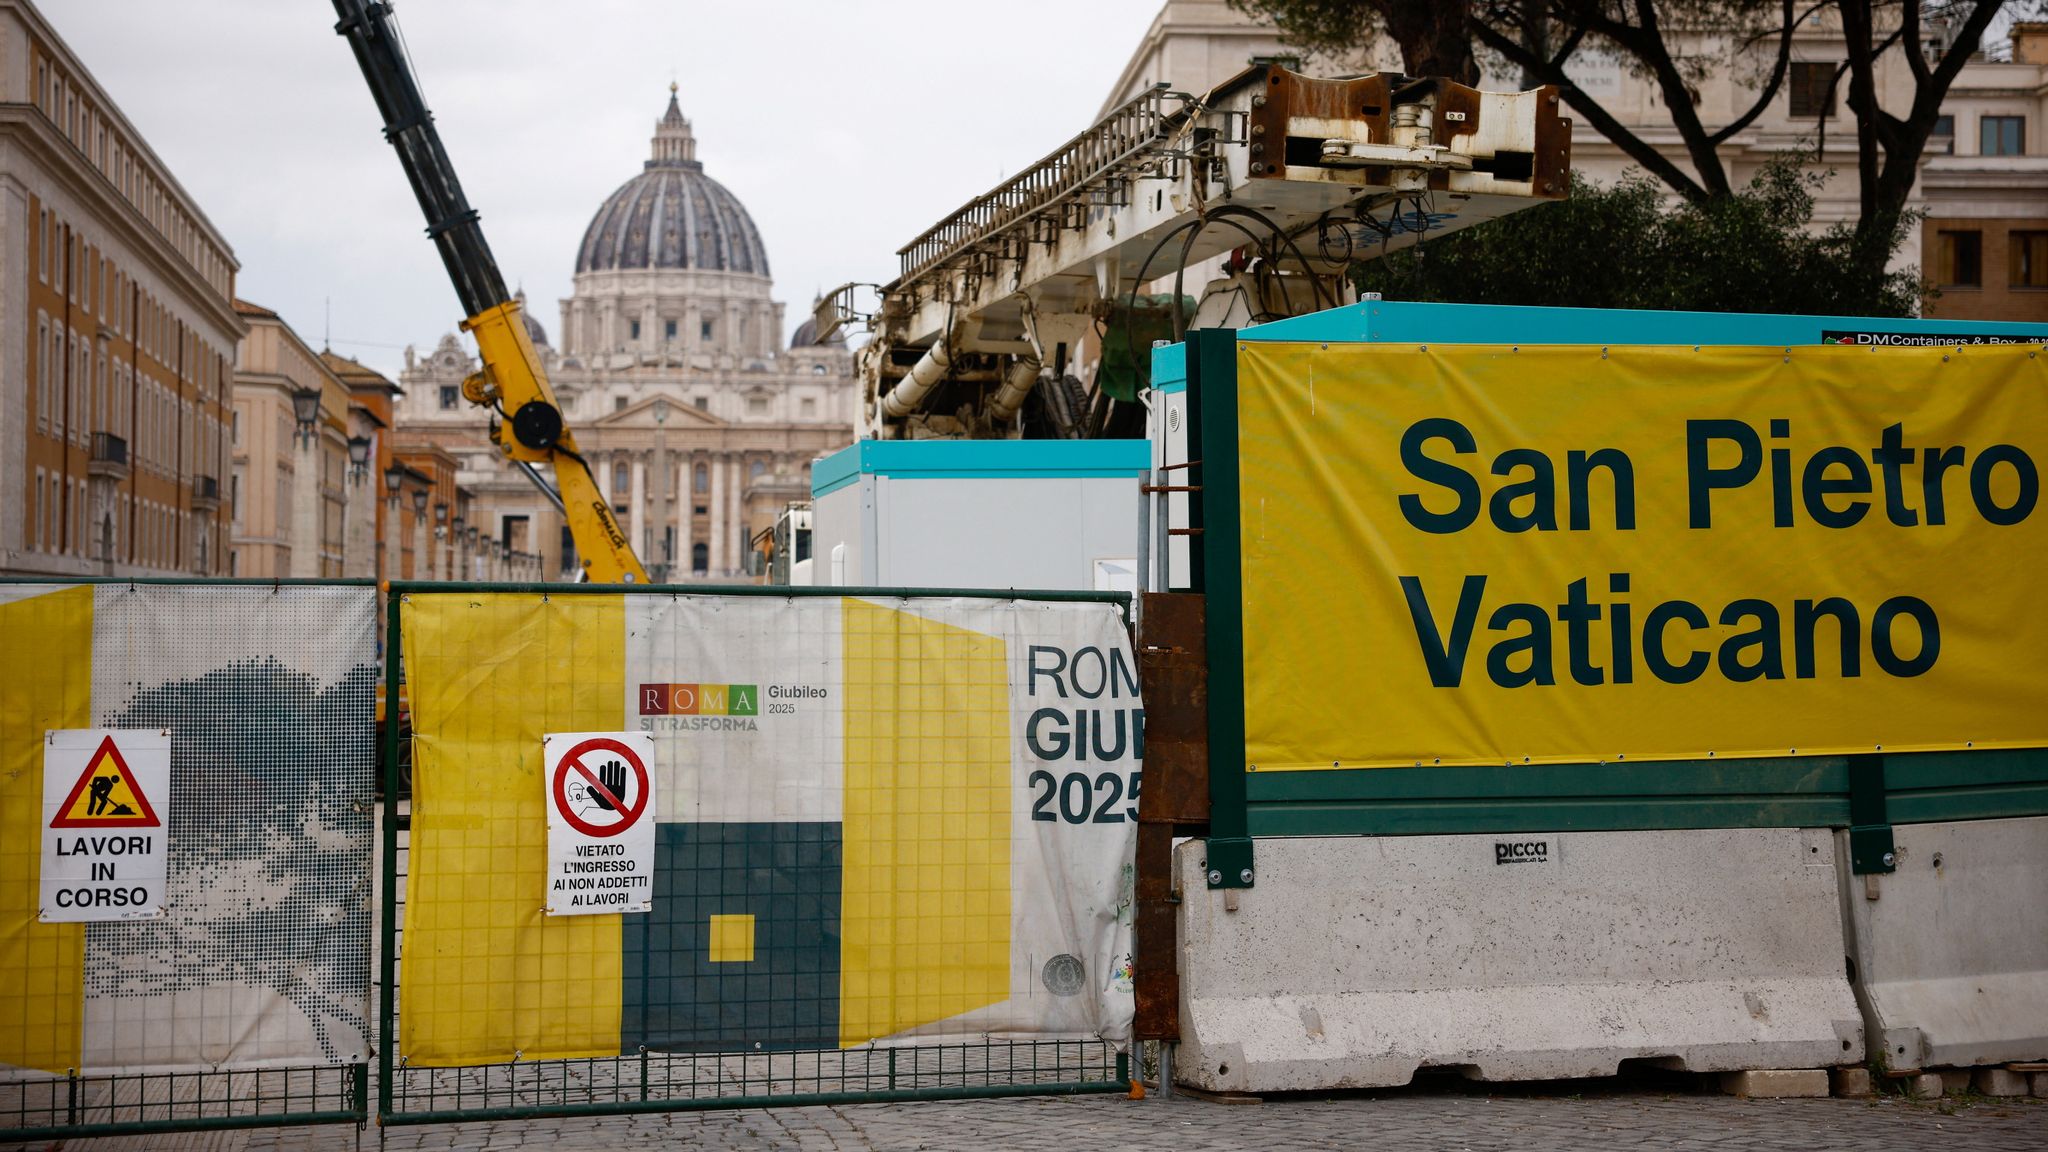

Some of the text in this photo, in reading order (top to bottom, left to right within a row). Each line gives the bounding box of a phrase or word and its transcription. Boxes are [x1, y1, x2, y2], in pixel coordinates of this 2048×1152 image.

[1398, 417, 2039, 534] San Pietro
[1398, 573, 1941, 688] Vaticano
[645, 688, 752, 711] ROMA
[768, 685, 827, 699] Giubileo
[768, 703, 795, 714] 2025
[640, 717, 759, 732] SI TRASFORMA
[57, 836, 152, 856] LAVORI
[576, 844, 625, 857] VIETATO
[1495, 842, 1547, 865] picca
[91, 862, 115, 881] IN
[564, 860, 635, 874] L'INGRESSO
[553, 876, 648, 891] AI NON ADDETTI
[56, 887, 148, 908] CORSO
[571, 893, 629, 906] AI LAVORI
